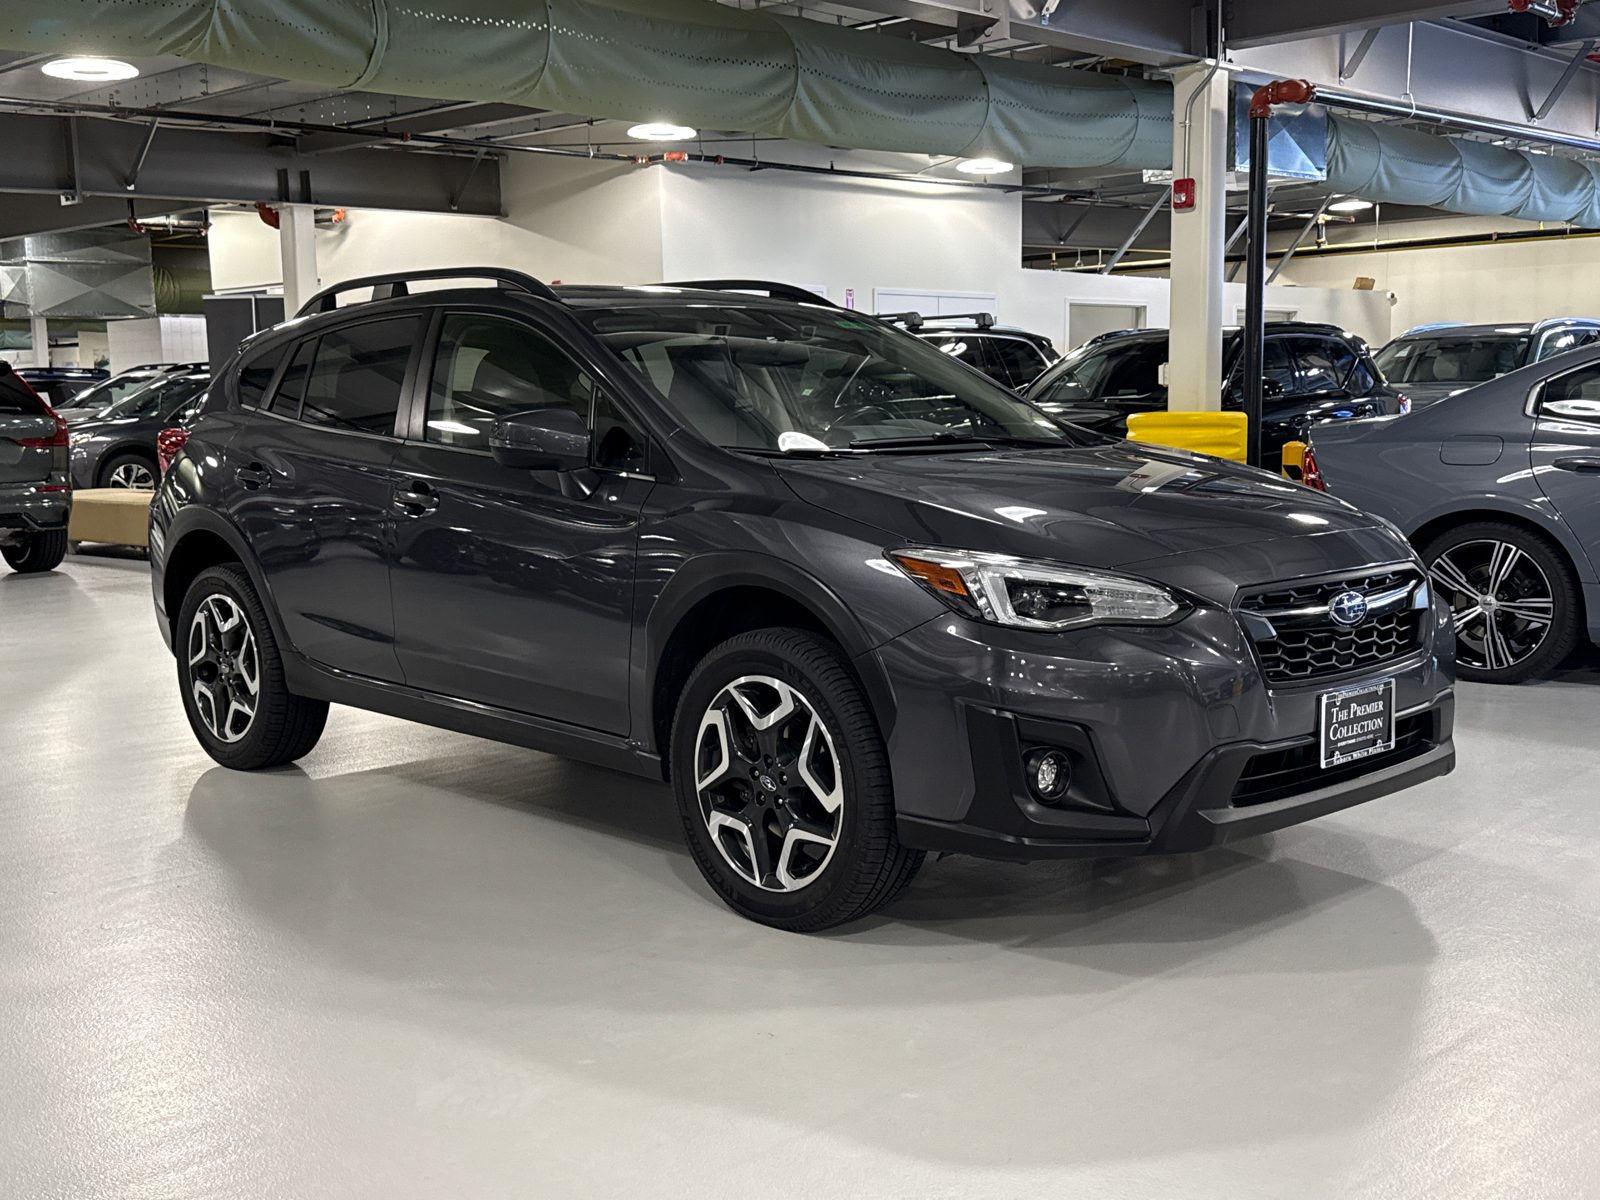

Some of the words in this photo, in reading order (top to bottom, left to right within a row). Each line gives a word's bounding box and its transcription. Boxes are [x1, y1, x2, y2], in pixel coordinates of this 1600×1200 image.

[1331, 707, 1349, 723] THE
[1350, 701, 1384, 718] PREMIER
[1330, 717, 1384, 740] COLLECTION
